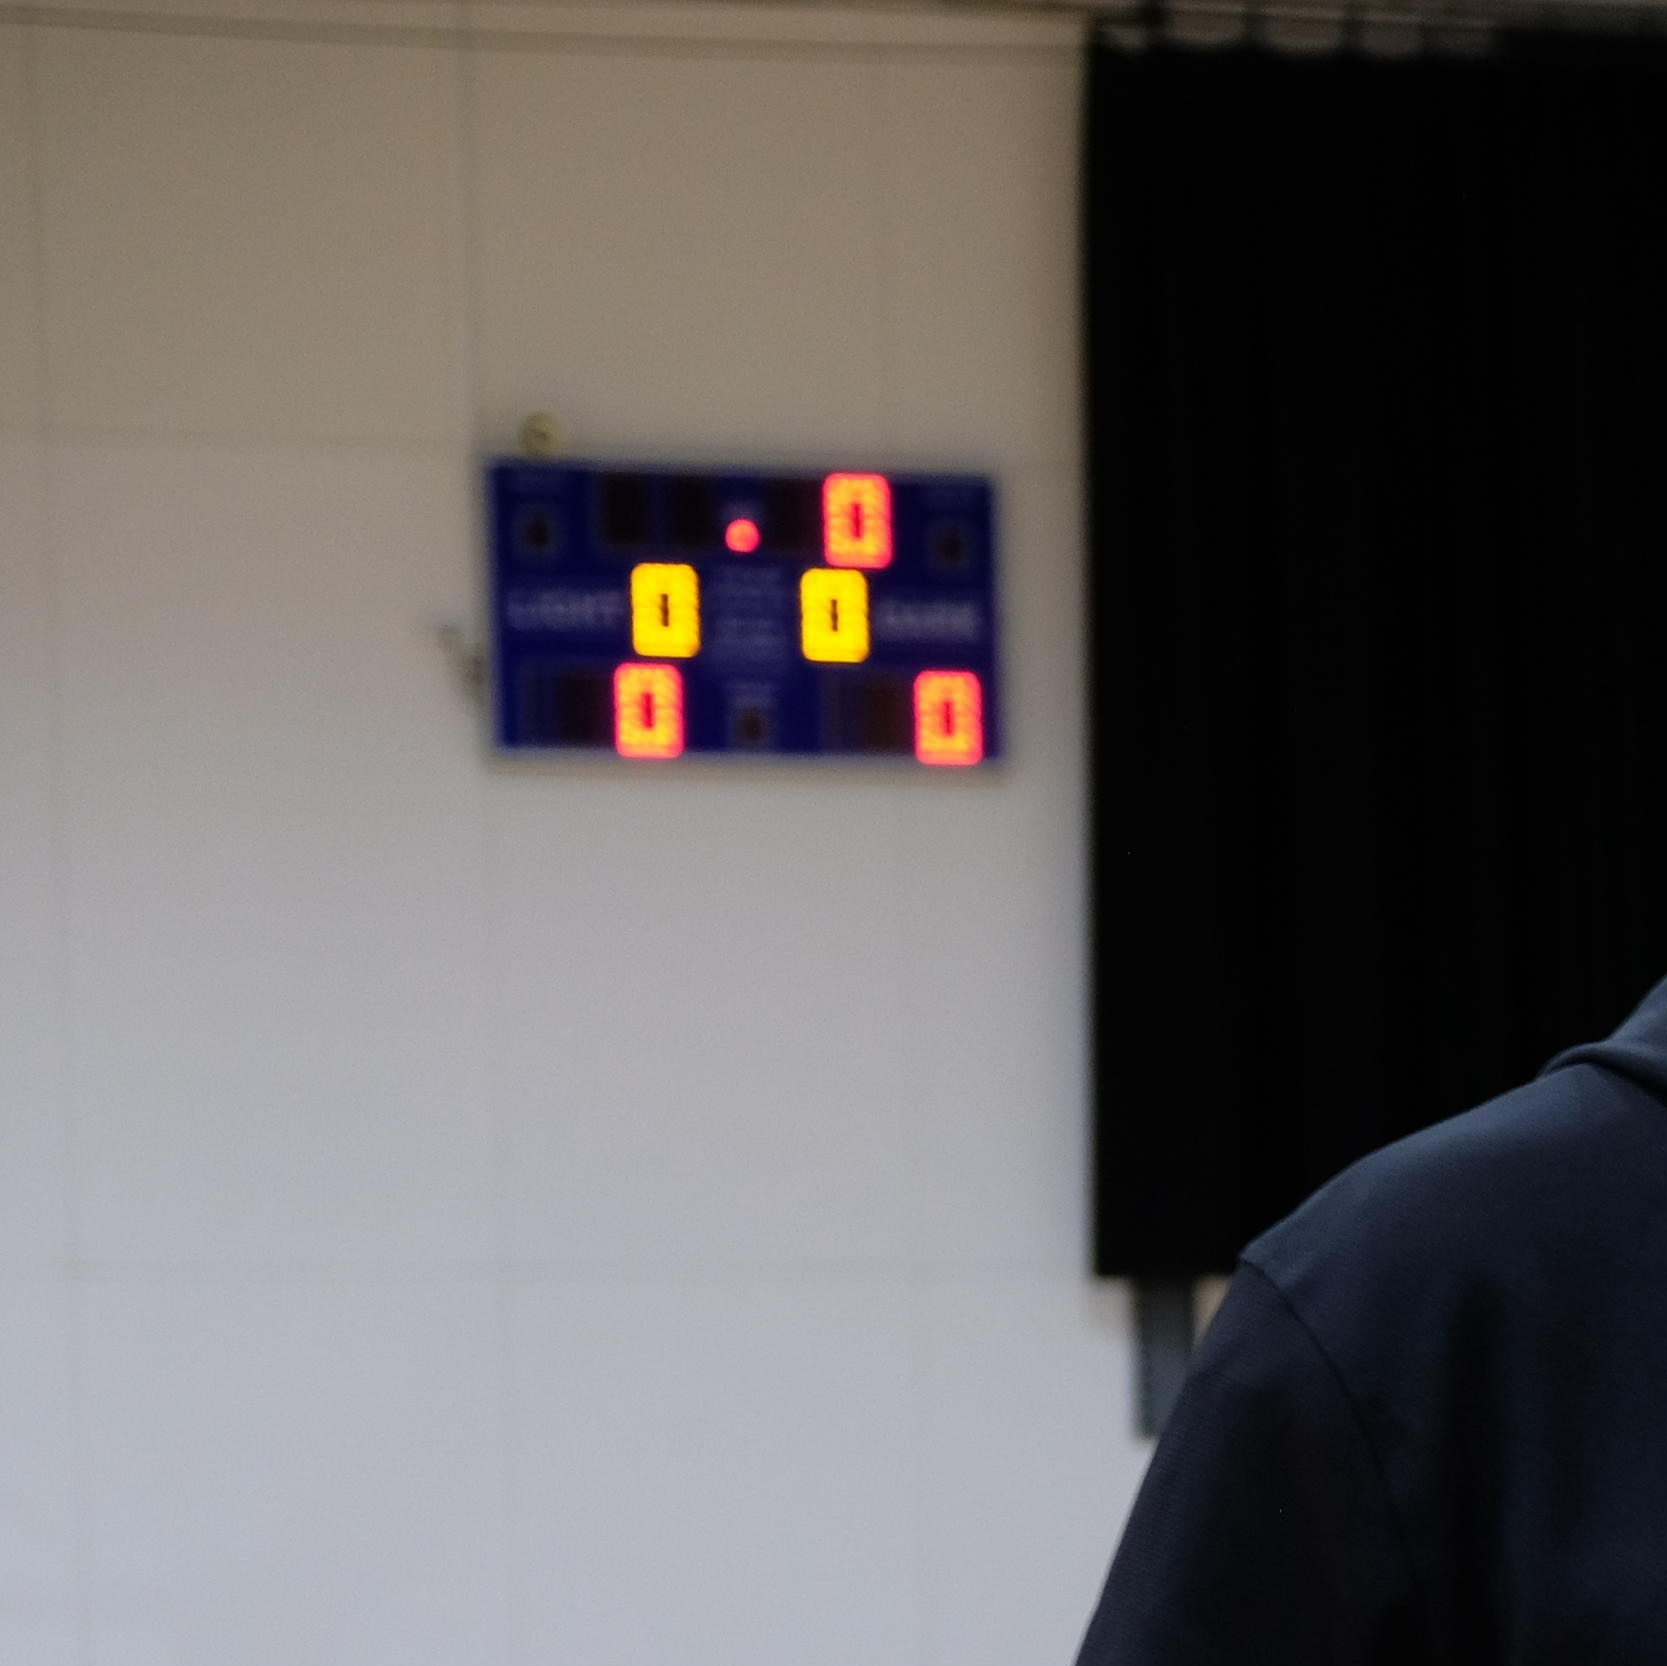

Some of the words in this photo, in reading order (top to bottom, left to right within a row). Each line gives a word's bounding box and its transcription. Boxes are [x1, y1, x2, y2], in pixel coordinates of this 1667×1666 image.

[823, 472, 892, 570] 0
[631, 563, 700, 659] 0
[801, 568, 870, 663] 0
[613, 662, 684, 759] 0
[914, 670, 984, 766] 0
